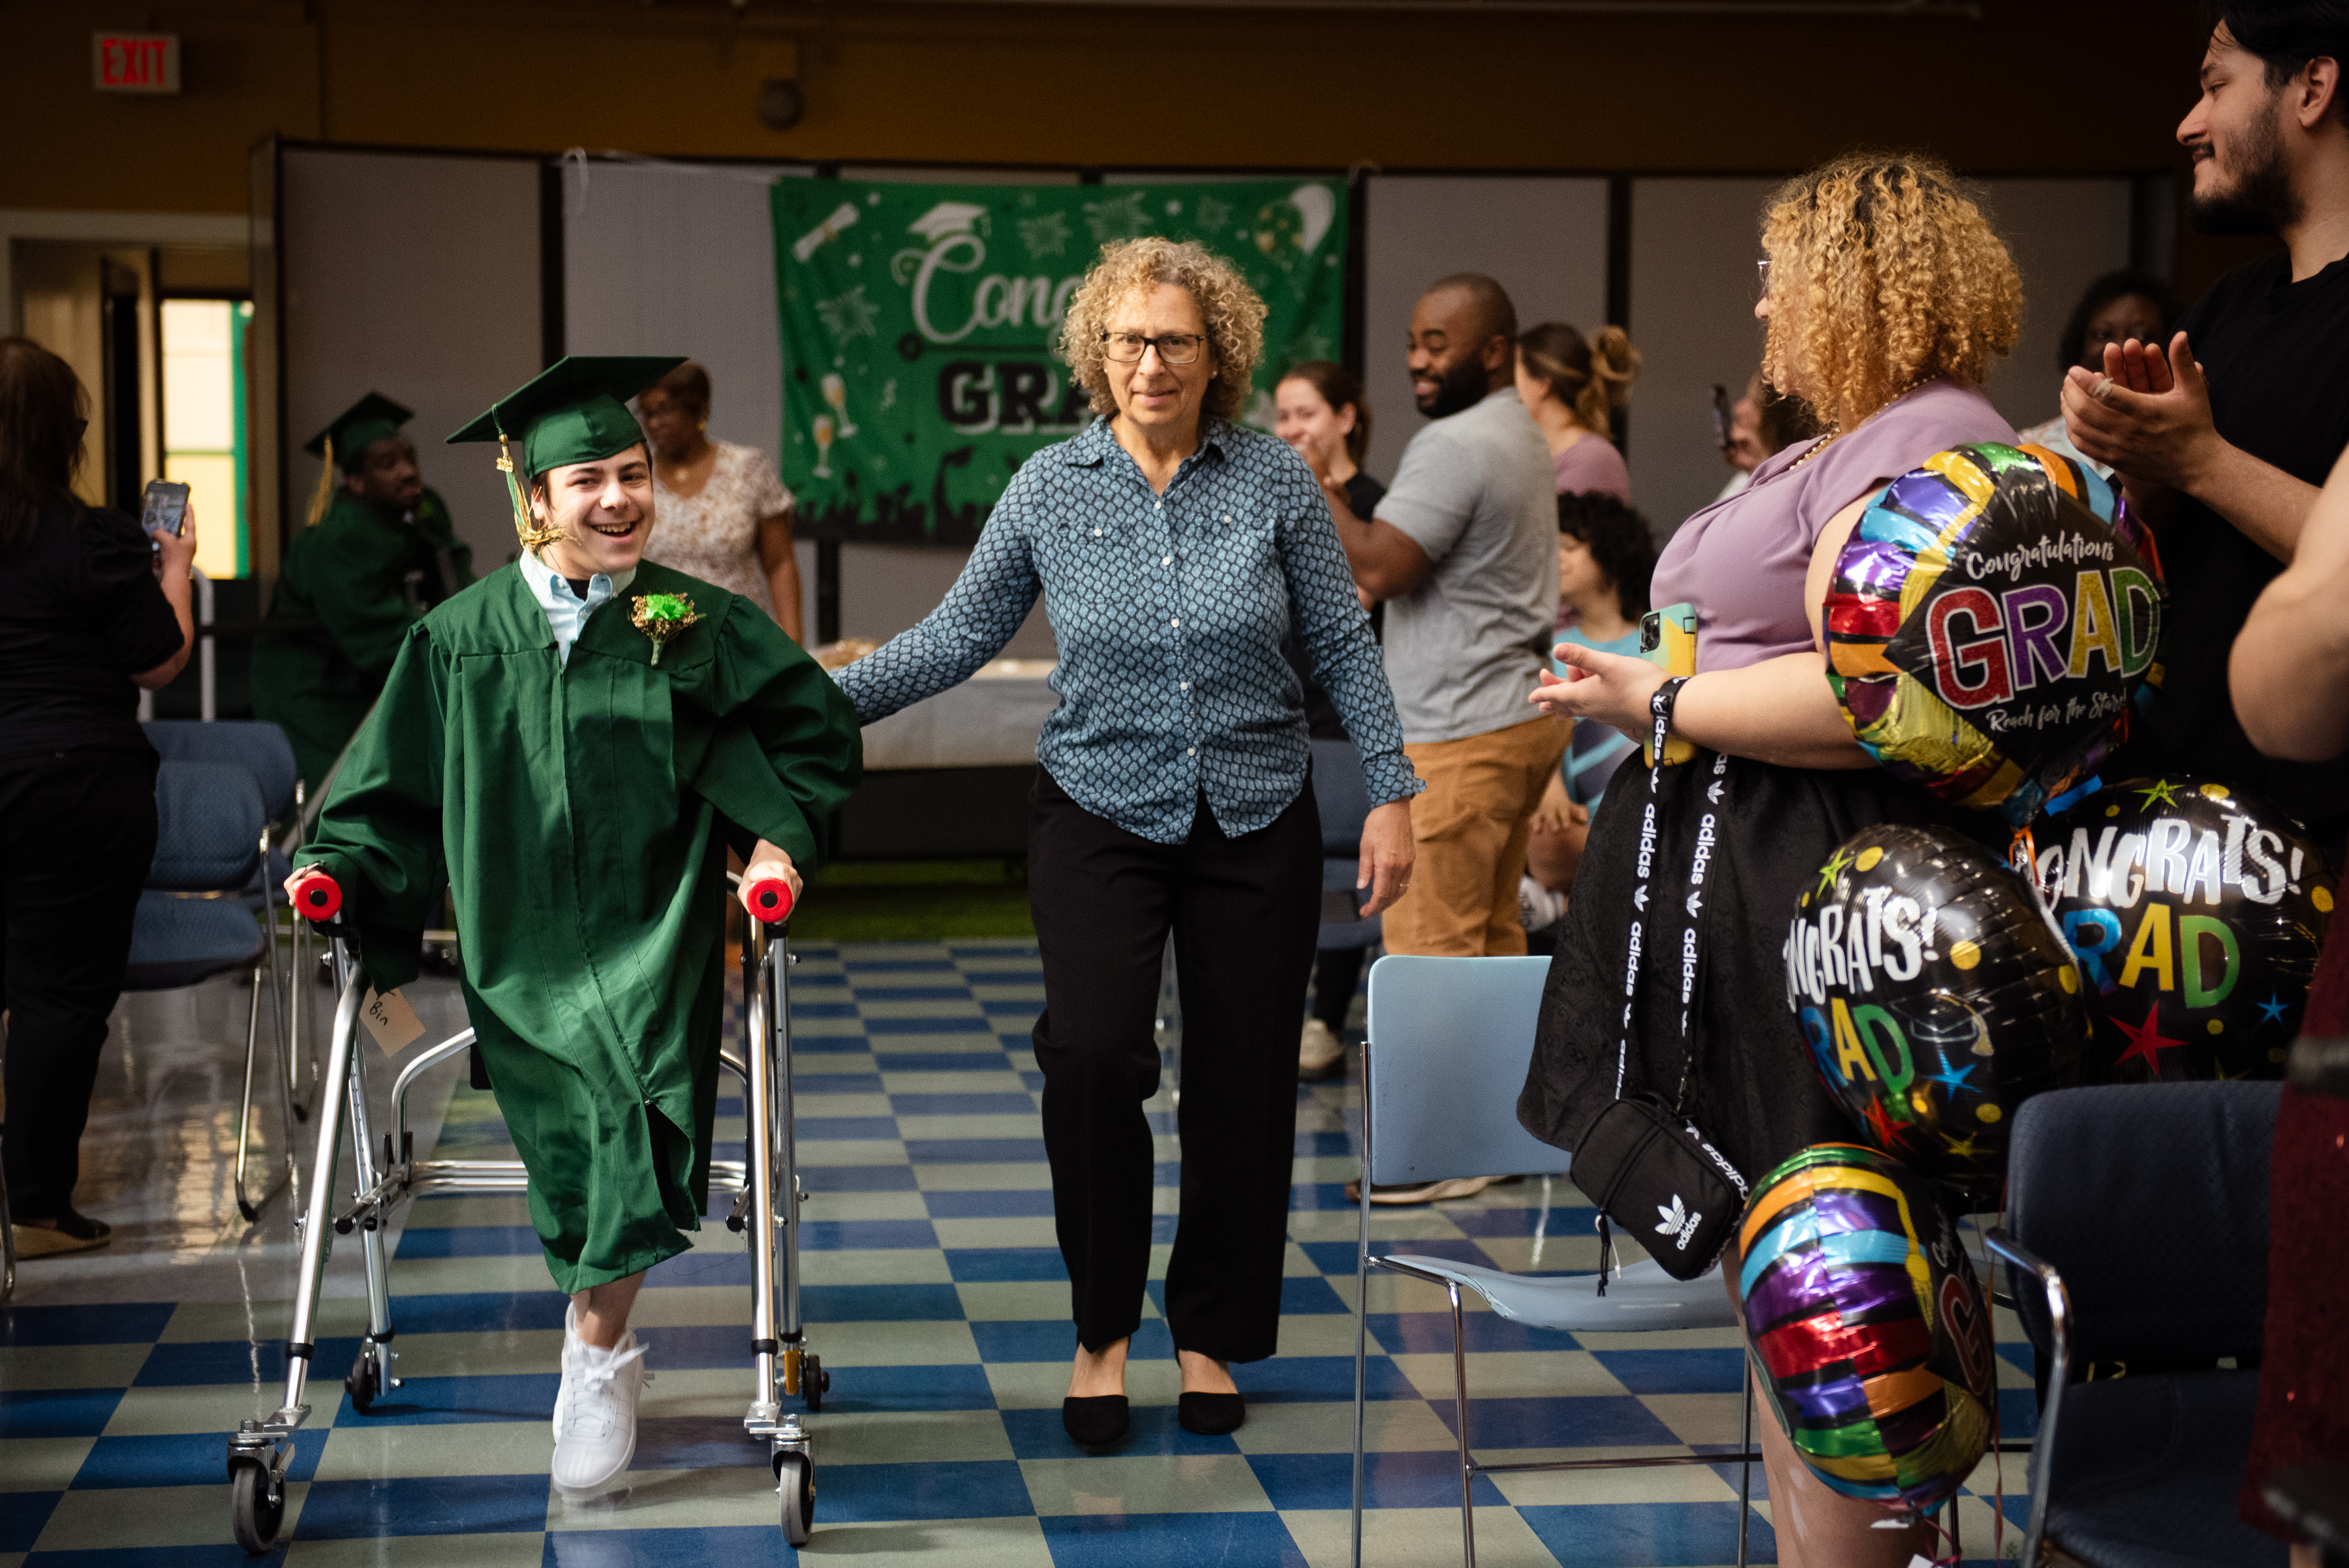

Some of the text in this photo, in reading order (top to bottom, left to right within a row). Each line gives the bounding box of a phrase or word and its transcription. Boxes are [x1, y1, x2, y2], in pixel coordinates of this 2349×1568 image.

[102, 38, 168, 86] EXIT
[1965, 529, 2114, 582] Congratulations
[1926, 566, 2161, 710] GRAD
[1986, 709, 2034, 732] Reach
[2037, 704, 2061, 730] for
[2065, 696, 2087, 724] the
[1637, 803, 1657, 878] adidas
[1691, 814, 1716, 885] adidas
[2037, 814, 2305, 912] ONGRATS!
[1625, 921, 1642, 997] adidas
[1681, 927, 1698, 1004] adidas
[2064, 902, 2241, 1009] RAD
[1801, 997, 1915, 1093] RAD
[1676, 1211, 1702, 1251] adidas
